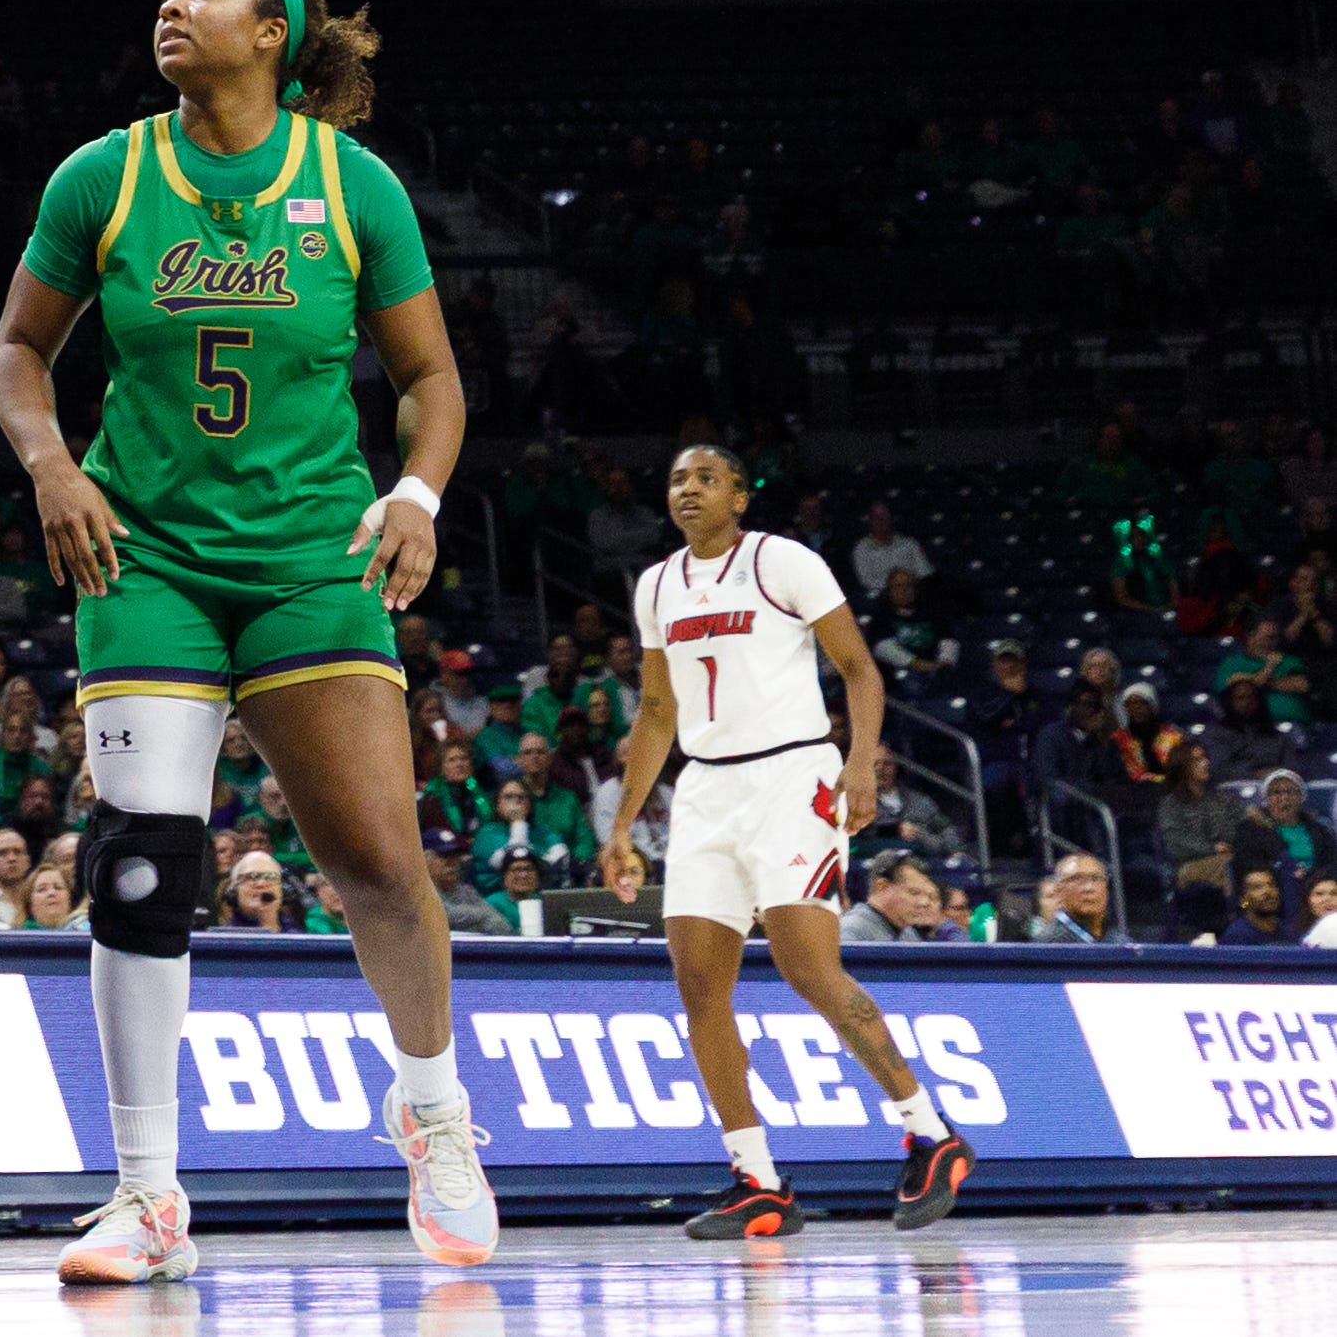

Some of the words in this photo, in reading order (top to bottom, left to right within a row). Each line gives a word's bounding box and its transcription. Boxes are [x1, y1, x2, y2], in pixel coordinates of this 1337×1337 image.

[153, 240, 297, 305] Irish
[193, 325, 254, 439] 5
[1211, 1078, 1337, 1131] IRIS
